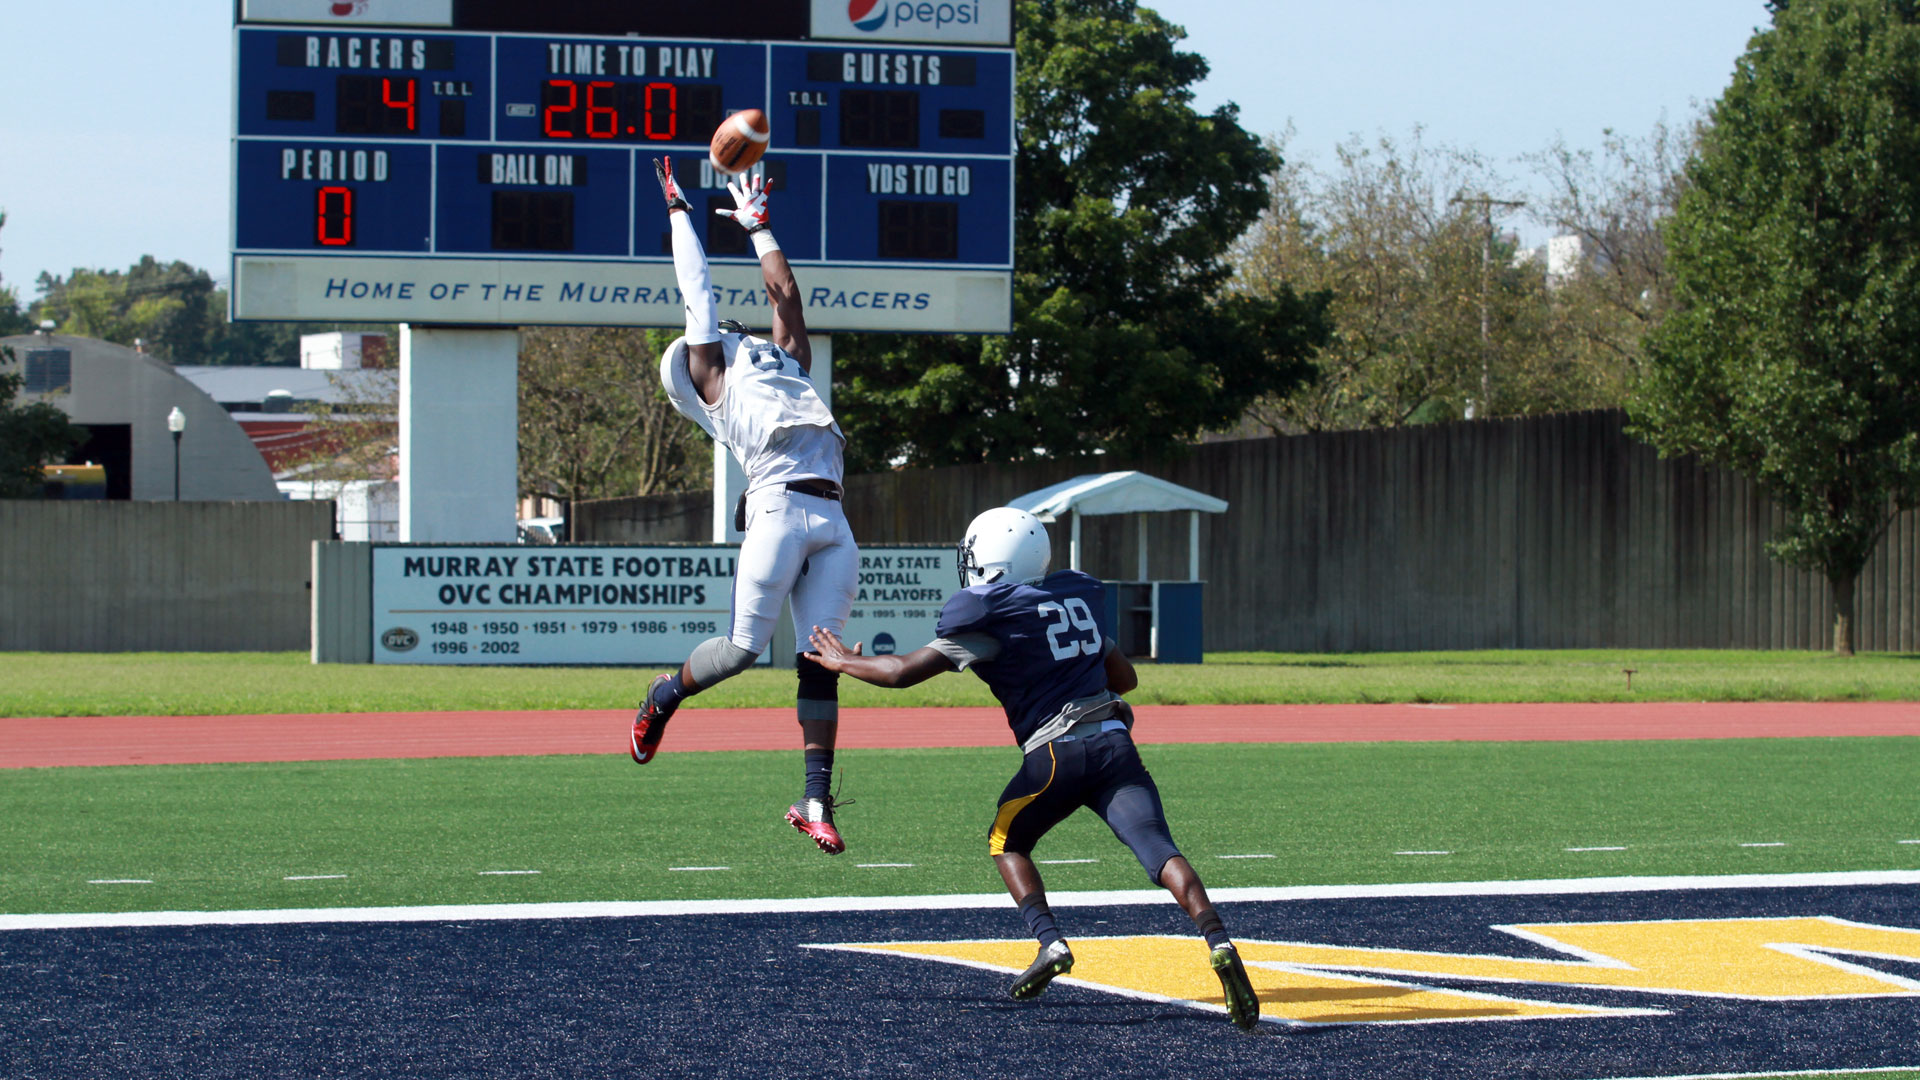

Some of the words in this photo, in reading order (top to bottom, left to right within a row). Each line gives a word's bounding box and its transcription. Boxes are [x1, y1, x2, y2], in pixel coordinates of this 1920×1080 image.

[894, 0, 979, 28] pepsi
[306, 36, 426, 70] RACERS
[549, 44, 606, 75] TIME
[618, 46, 646, 76] TO
[658, 47, 714, 78] PLAY
[842, 52, 941, 85] GUESTS
[382, 78, 415, 130] 4
[545, 80, 676, 139] 26.0
[282, 149, 388, 181] PERIOD
[491, 153, 538, 185] BALL
[544, 155, 573, 185] ON
[867, 162, 908, 195] YDS
[912, 163, 937, 195] TO
[942, 165, 970, 196] GO
[317, 186, 352, 246] 0
[404, 556, 518, 577] MURRAY
[527, 556, 603, 577] STATE
[858, 572, 921, 585] OOTBALL
[860, 556, 892, 569] RAY
[897, 557, 941, 569] STATE
[438, 584, 490, 605] OVC
[500, 584, 706, 605] CHAMPIONSHIPS
[874, 588, 942, 601] PLAYOFFS
[431, 622, 468, 634] 1948
[482, 622, 519, 634] 1950
[532, 622, 567, 634] 1951
[581, 622, 618, 634] 1979
[631, 622, 668, 634] 1986
[681, 622, 717, 634] 1995
[1038, 598, 1102, 661] 29
[481, 642, 520, 654] 2002
